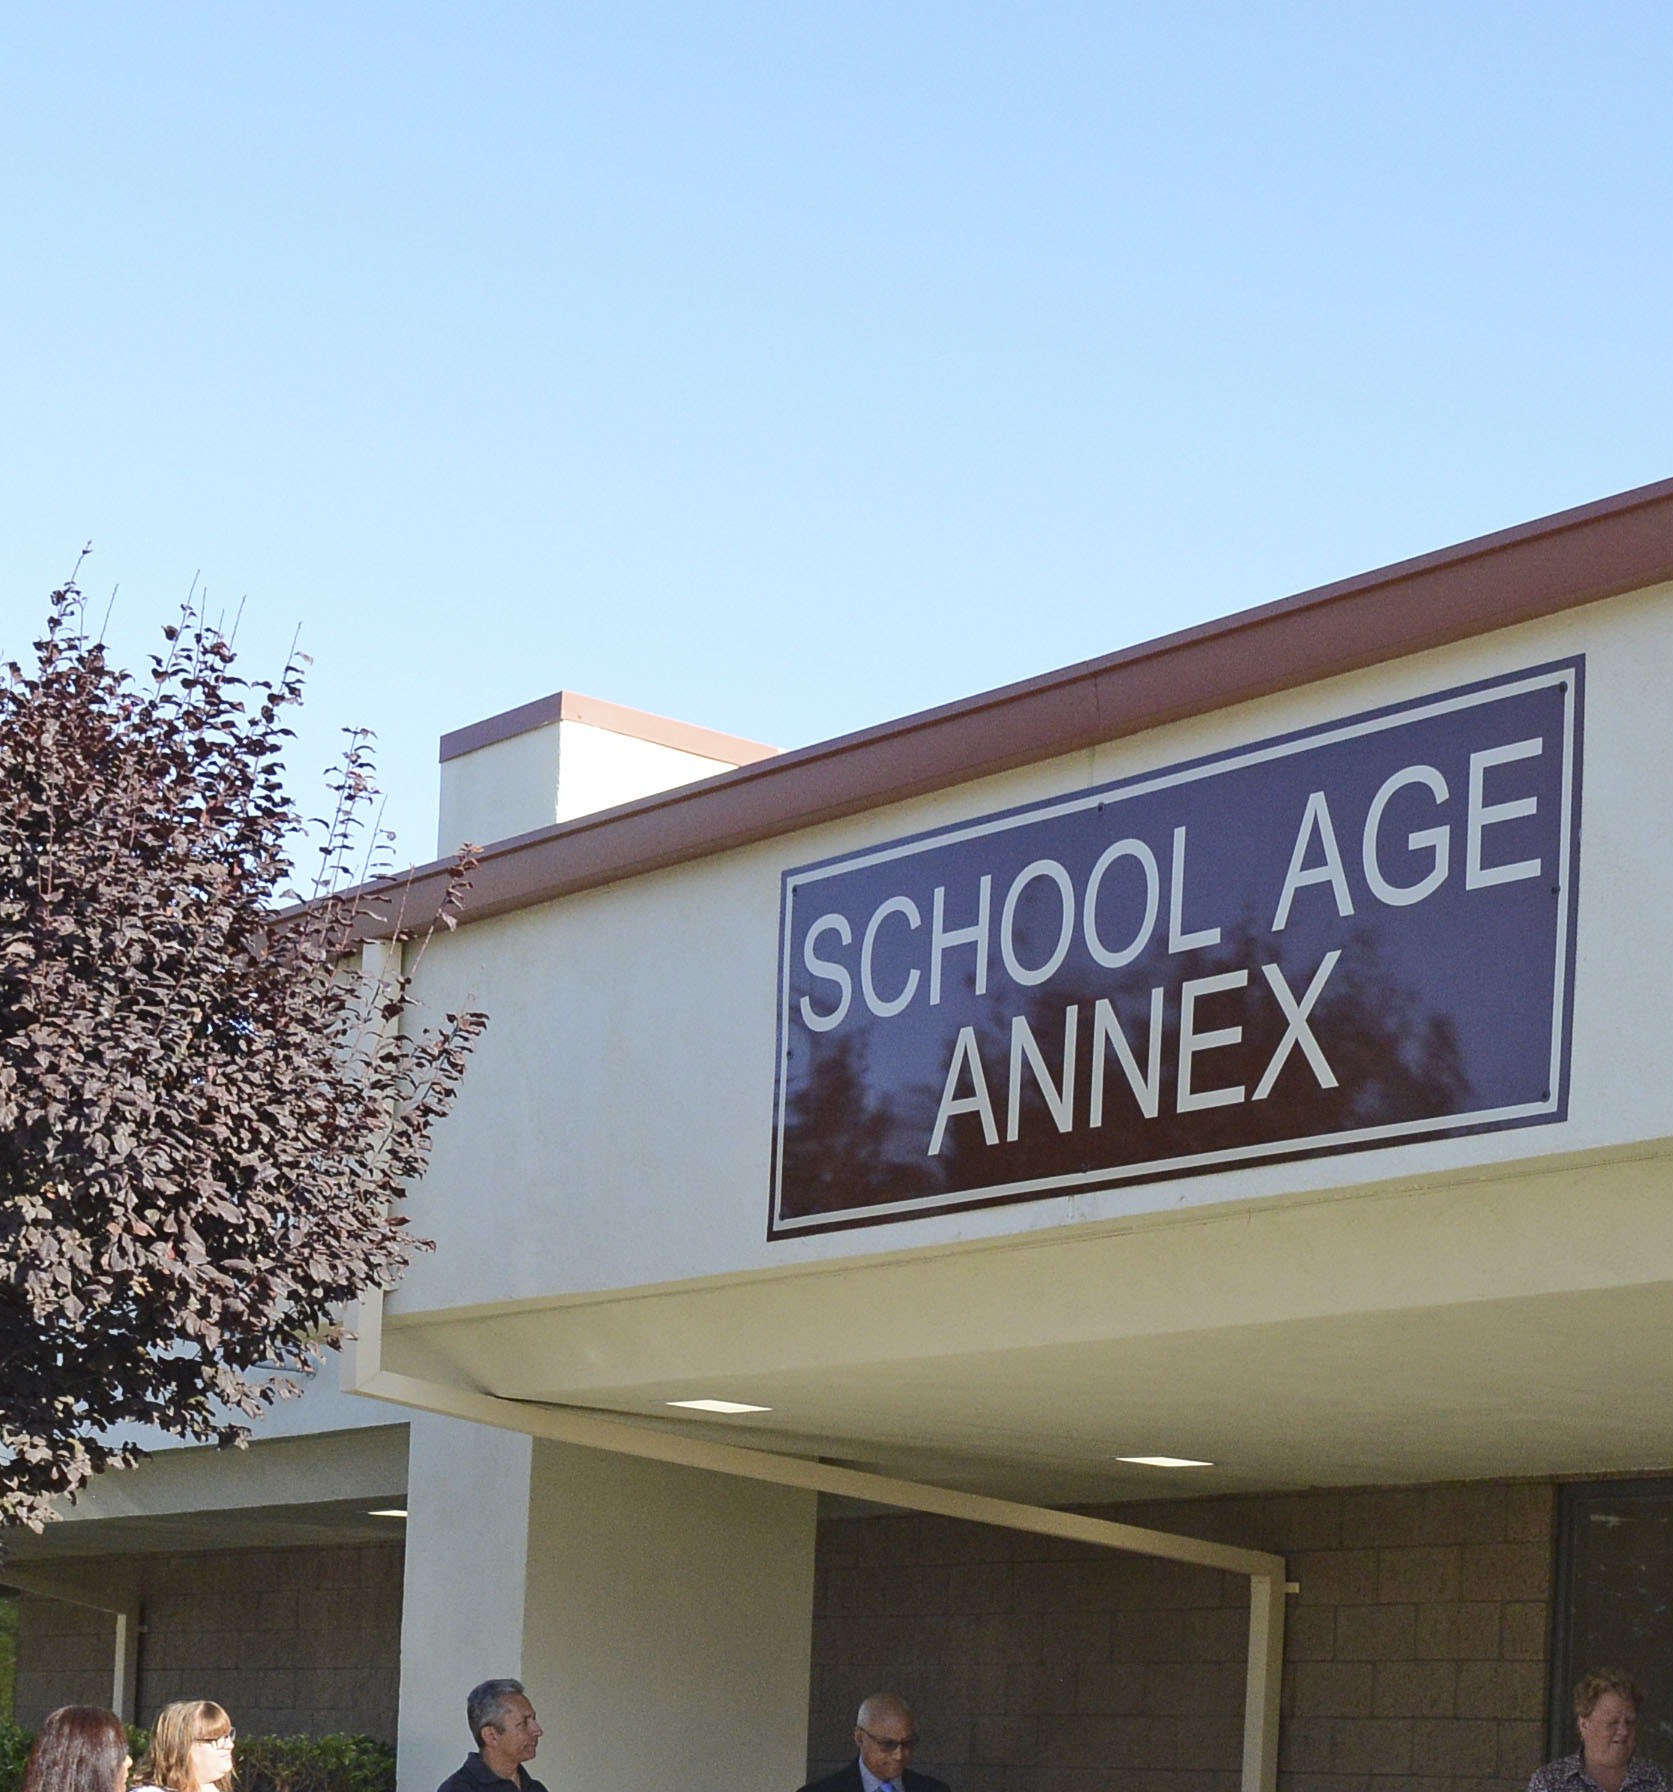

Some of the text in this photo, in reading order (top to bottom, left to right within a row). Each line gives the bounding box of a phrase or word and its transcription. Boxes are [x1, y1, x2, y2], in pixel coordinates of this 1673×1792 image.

[799, 737, 1544, 1033] SCHOOL AGE
[927, 950, 1342, 1157] ANNEX
